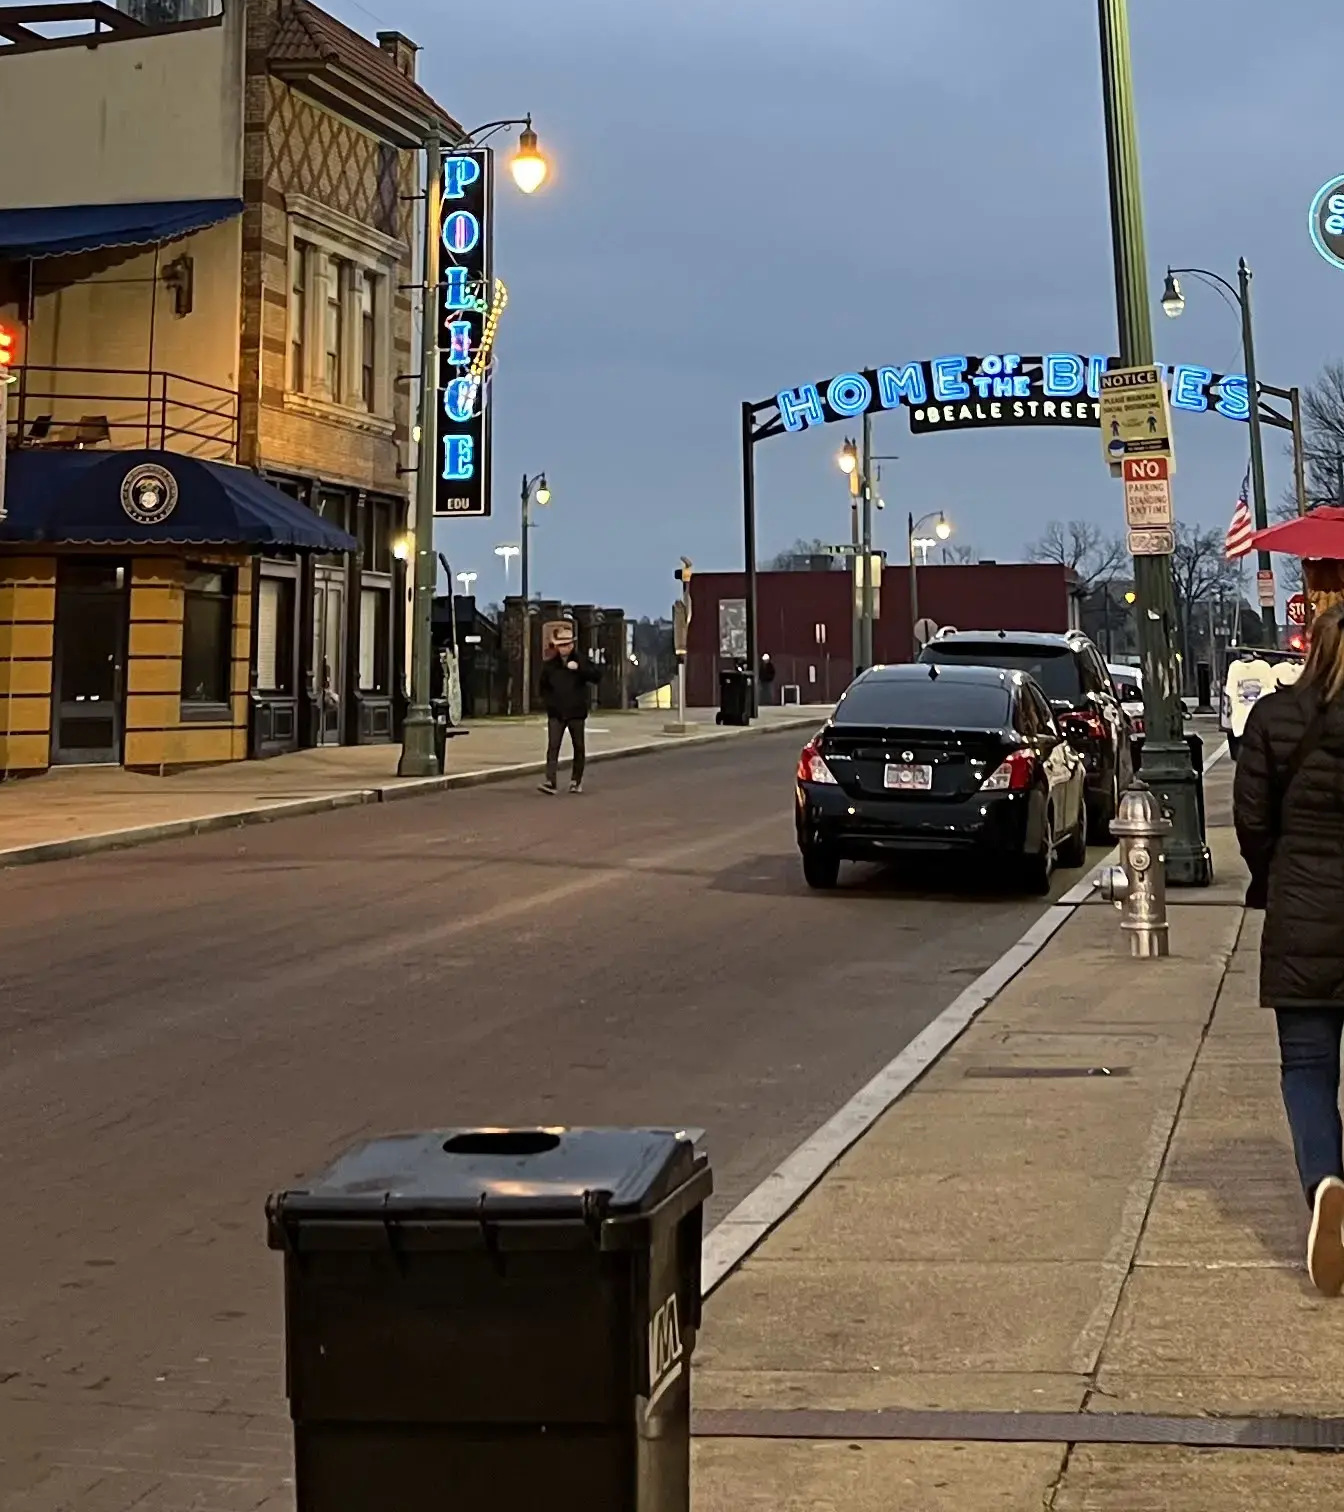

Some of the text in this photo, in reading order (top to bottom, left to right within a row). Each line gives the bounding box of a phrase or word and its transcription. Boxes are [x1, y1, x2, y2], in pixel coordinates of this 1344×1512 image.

[441, 155, 481, 481] POLICE
[1101, 371, 1156, 388] NOTICE
[776, 351, 1253, 433] HOME OF THE BLES
[925, 400, 1101, 425] BEALE STREET
[1131, 460, 1160, 478] NO
[1128, 482, 1164, 492] PARKING
[447, 497, 470, 510] EDU
